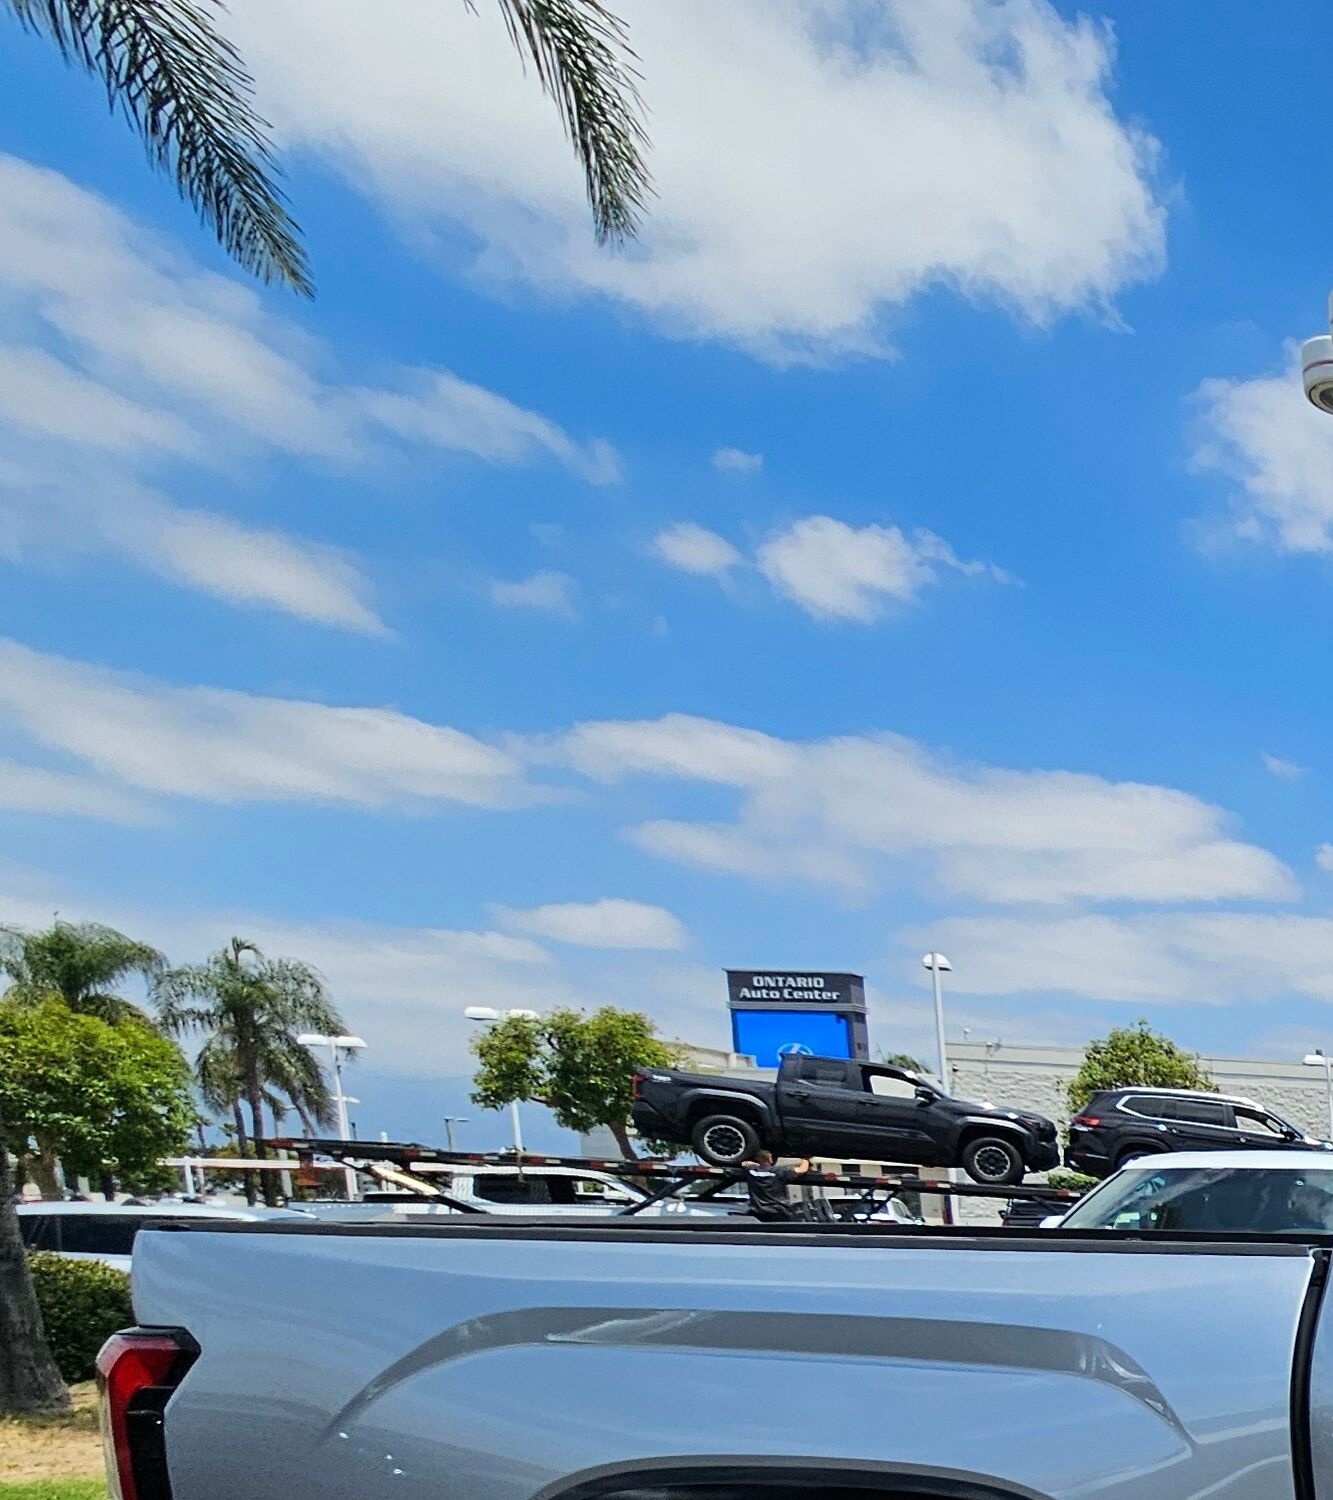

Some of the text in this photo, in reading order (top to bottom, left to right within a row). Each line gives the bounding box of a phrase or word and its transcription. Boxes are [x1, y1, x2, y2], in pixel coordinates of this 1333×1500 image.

[752, 975, 825, 988] ONTARIO
[739, 987, 841, 1001] Auto Center
